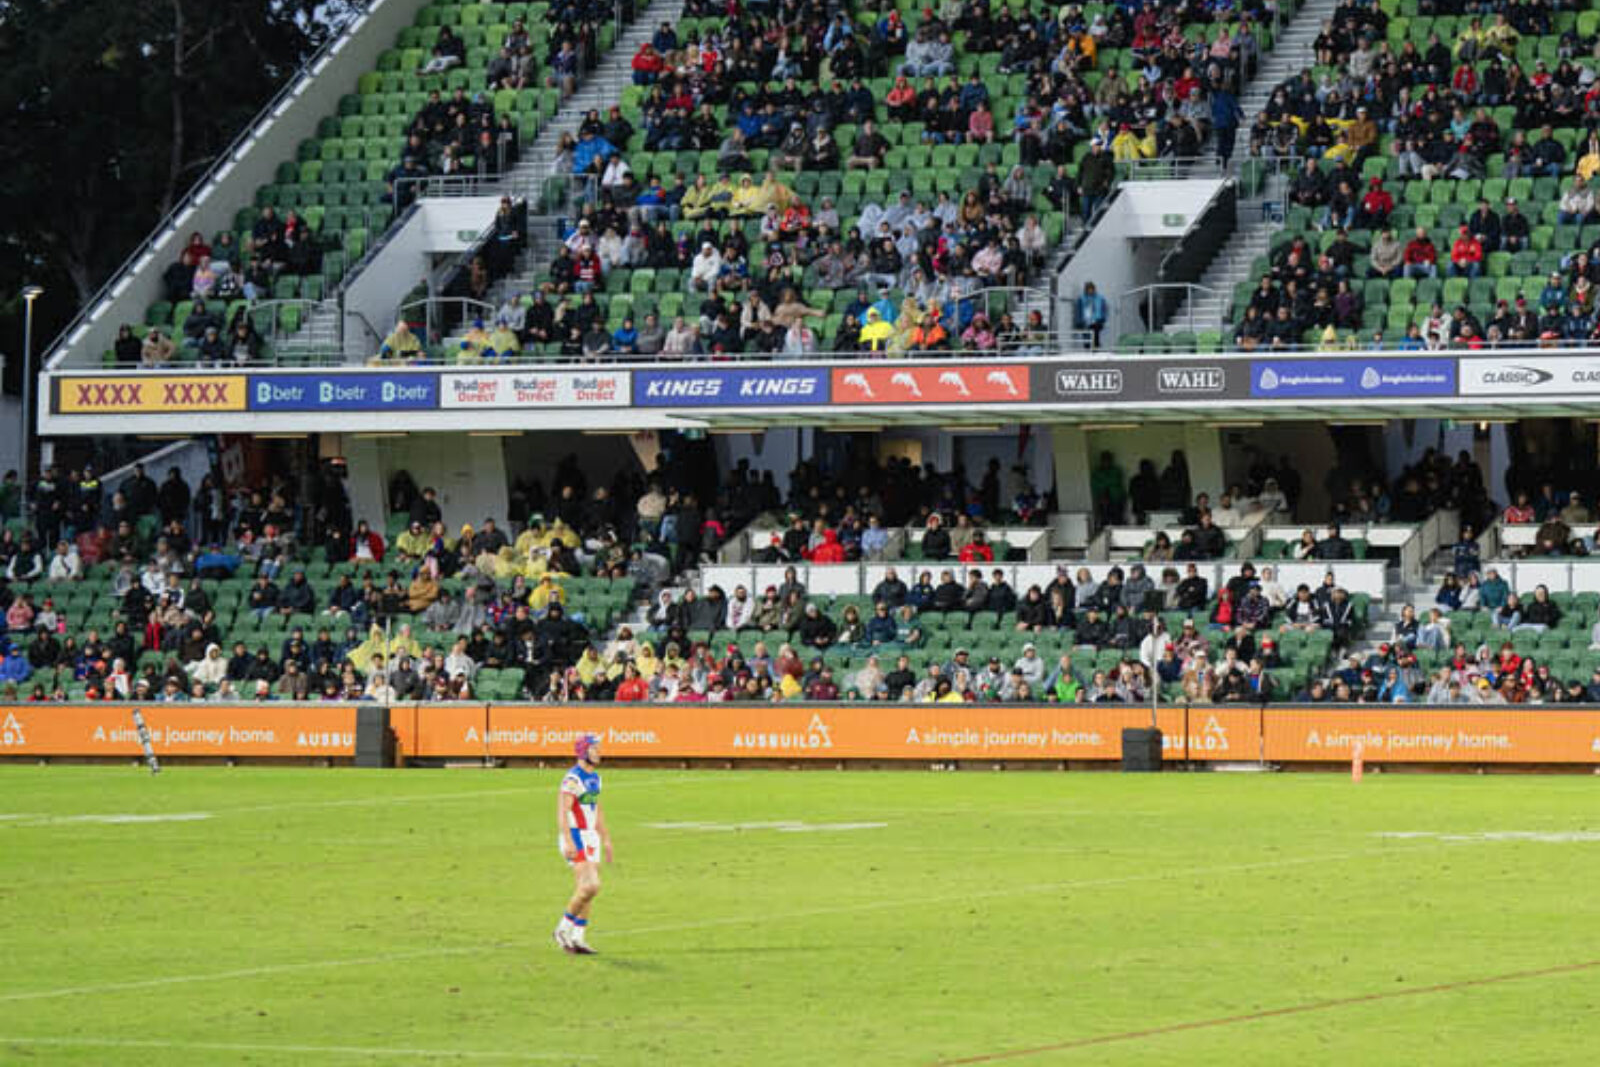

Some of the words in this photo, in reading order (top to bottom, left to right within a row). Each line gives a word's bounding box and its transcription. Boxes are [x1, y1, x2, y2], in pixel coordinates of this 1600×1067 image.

[513, 378, 557, 392] Budget
[571, 377, 616, 391] Budget
[1061, 371, 1118, 390] WAHL
[1161, 369, 1220, 388] WAHL
[1482, 369, 1535, 385] CLASSIC
[272, 386, 303, 401] betr
[335, 385, 366, 400] betr
[397, 384, 429, 400] betr
[453, 379, 498, 392] Budget
[646, 379, 723, 397] KINGS
[739, 377, 817, 396] KINGS
[77, 384, 142, 406] XXXX
[163, 383, 228, 405] XXXX
[458, 390, 496, 403] Direct
[517, 389, 555, 402] Direct
[576, 388, 615, 401] Direct
[94, 726, 106, 743] A
[165, 725, 225, 746] journey
[297, 732, 353, 747] AUSBU
[465, 726, 478, 742] A
[483, 726, 538, 745] simple
[733, 733, 820, 748] AUSBUILD
[906, 727, 920, 744] A
[924, 727, 979, 747] simple
[983, 727, 1046, 749] journey
[1307, 729, 1320, 746] A
[1388, 729, 1452, 751] journey
